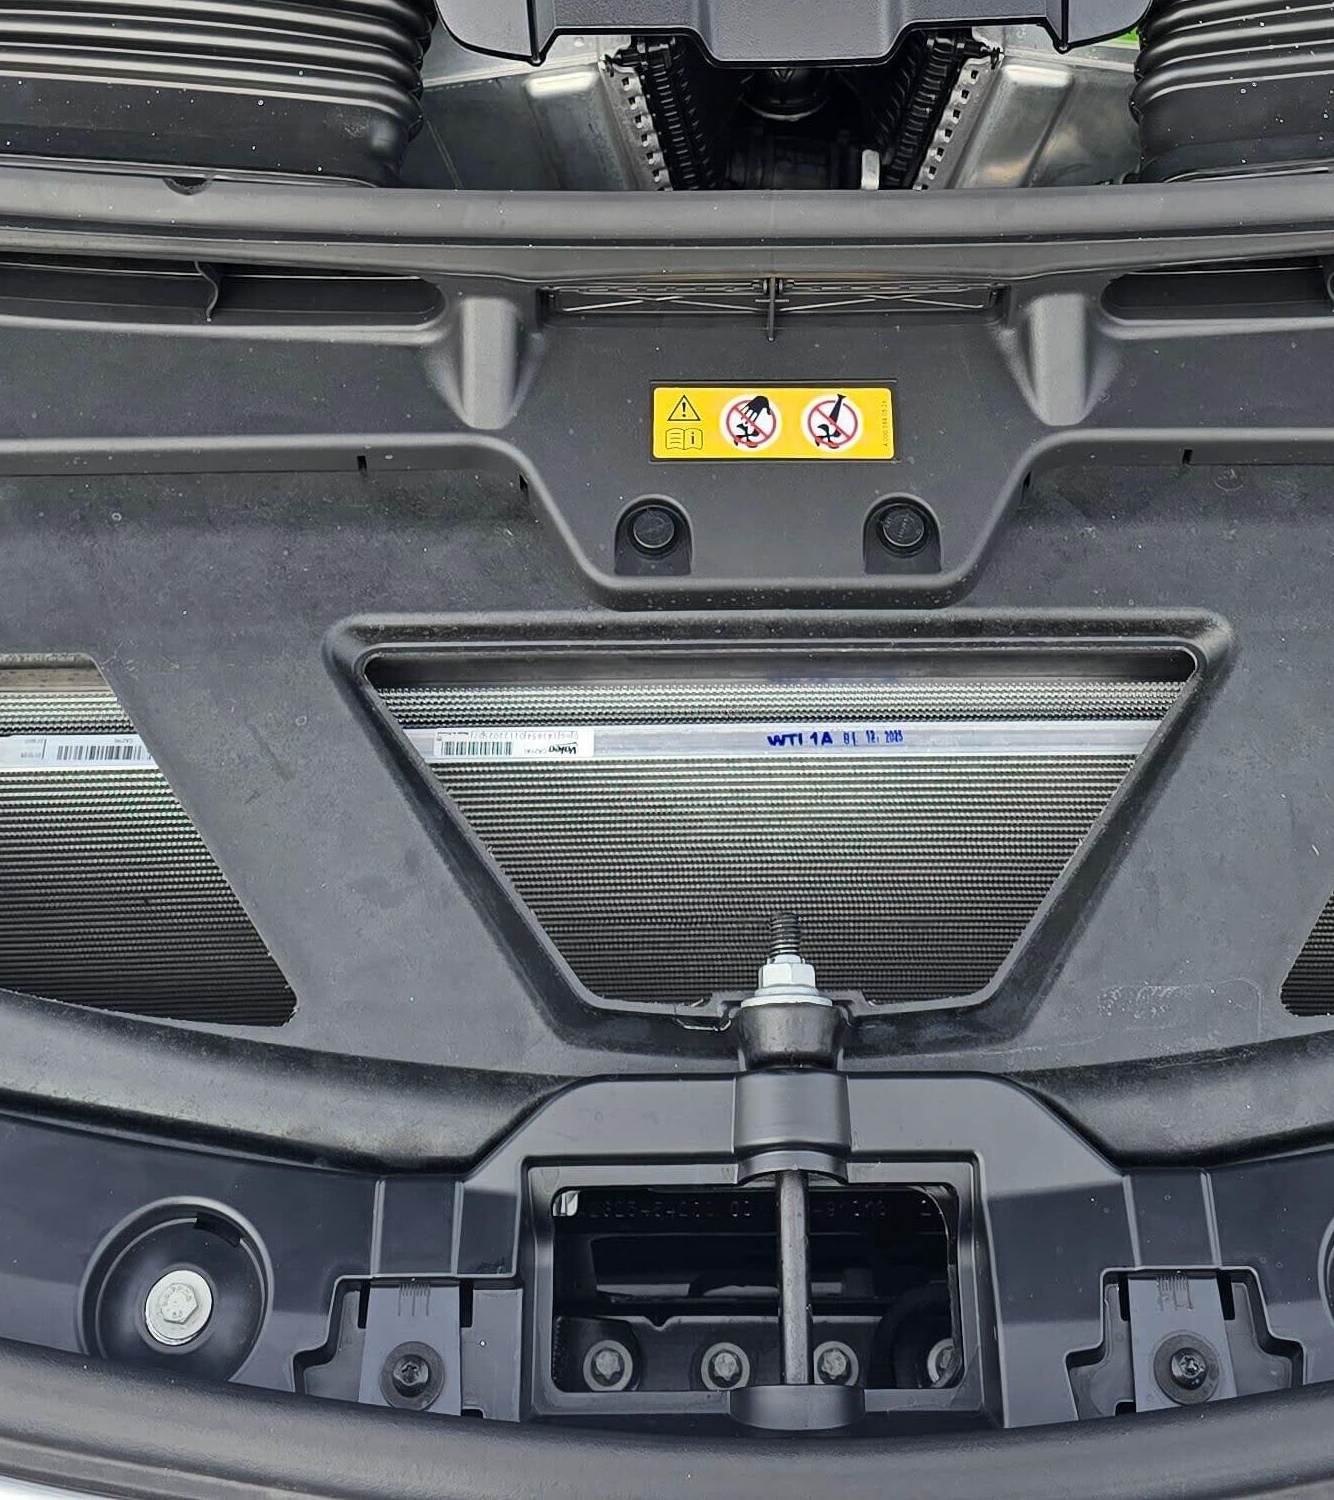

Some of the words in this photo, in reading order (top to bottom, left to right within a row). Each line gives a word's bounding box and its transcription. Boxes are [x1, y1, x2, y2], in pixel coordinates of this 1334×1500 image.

[767, 733, 803, 746] WTI
[810, 731, 833, 745] 1A
[548, 746, 577, 755] Valeo
